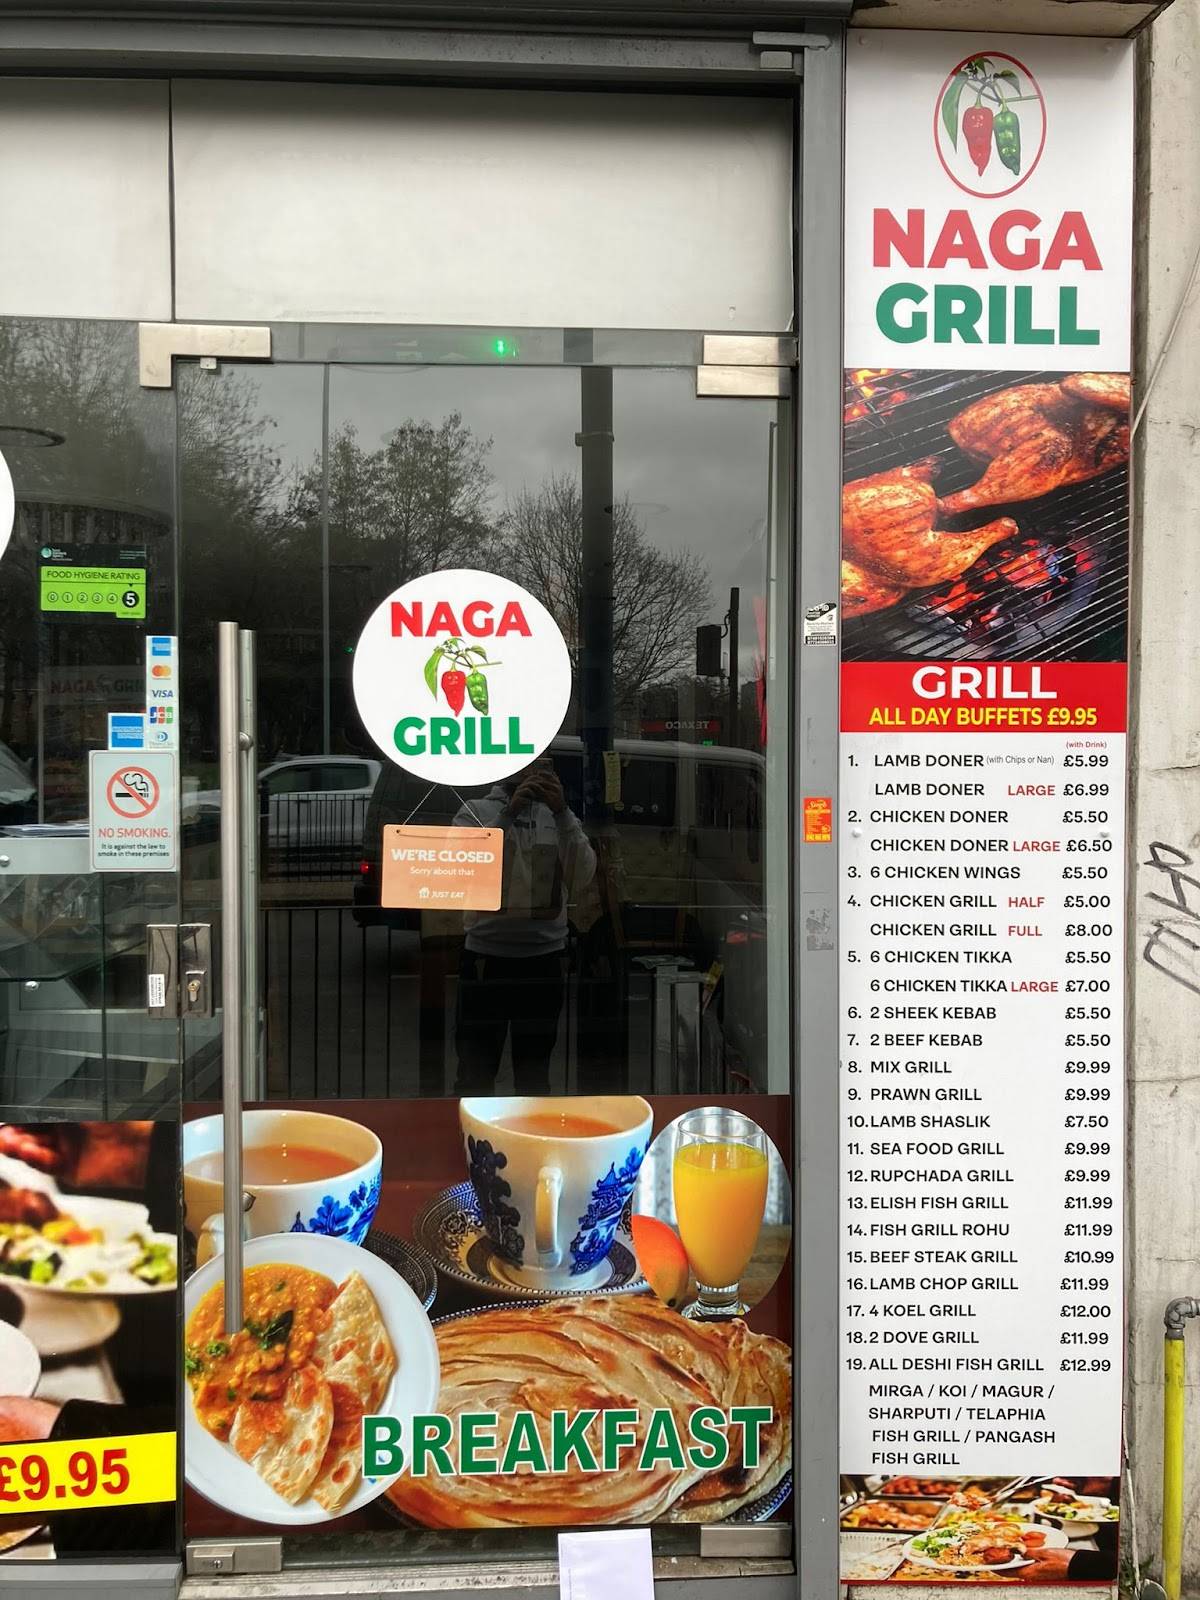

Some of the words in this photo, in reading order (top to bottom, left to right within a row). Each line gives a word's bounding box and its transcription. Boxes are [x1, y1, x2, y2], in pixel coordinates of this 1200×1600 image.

[873, 208, 1103, 271] NAGA
[875, 282, 1100, 345] GRILL
[47, 570, 72, 578] FOOD
[74, 571, 109, 579] HYGIENE
[111, 572, 140, 580] RATING
[126, 593, 136, 606] 5
[391, 600, 532, 637] NAGA
[912, 666, 1057, 699] GRILL
[152, 690, 173, 698] VISA
[869, 707, 905, 725] ALL
[911, 707, 951, 725] DAY
[957, 707, 1042, 725] BUFFETS
[1047, 707, 1097, 726] £9.95
[393, 716, 534, 756] GRILL
[1066, 741, 1084, 749] (with
[1086, 741, 1107, 749] Drink)
[875, 755, 920, 767] LAMB
[926, 755, 984, 767] DONER
[986, 755, 1003, 765] (with
[1005, 755, 1025, 766] Chips
[1028, 757, 1035, 765] or
[1037, 755, 1054, 765] Nan)
[1063, 755, 1108, 767] £5.99
[876, 784, 921, 796] LAMB
[926, 784, 984, 796] DONER
[1008, 784, 1055, 796] LARGE
[1063, 784, 1109, 796] £6.99
[848, 810, 861, 823] 2.
[870, 810, 945, 823] CHICKEN
[950, 810, 1008, 823] DONER
[1062, 810, 1108, 823] £5.50
[98, 828, 114, 838] NO
[871, 839, 945, 852] CHICKEN
[951, 839, 1008, 852] DONER
[1013, 839, 1060, 852] LARGE
[1066, 839, 1112, 852] £6.50
[391, 848, 437, 862] WE'RE
[438, 850, 495, 864] CLOSED
[410, 866, 431, 876] Sorry
[433, 867, 457, 876] about
[458, 868, 475, 876] that
[848, 866, 861, 879] 3.
[871, 866, 880, 879] 6
[885, 866, 959, 879] CHICKEN
[964, 866, 1020, 879] WINGS
[1062, 866, 1108, 879] £5.50
[431, 891, 449, 899] JUST
[450, 891, 465, 899] EAT
[847, 895, 861, 908] 4.
[870, 895, 944, 908] CHICKEN
[950, 895, 997, 908] GRILL
[1009, 895, 1045, 908] HALF
[1064, 895, 1110, 908] £5.00
[870, 924, 944, 936] CHICKEN
[950, 924, 997, 936] GRILL
[1008, 924, 1042, 936] FULL
[1065, 924, 1112, 936] £8.00
[848, 951, 860, 963] 5.
[870, 951, 880, 963] 6
[885, 951, 959, 963] CHICKEN
[963, 951, 1012, 963] TIKKA
[1065, 951, 1111, 963] £5.50
[870, 980, 880, 992] 6
[884, 980, 956, 992] CHICKEN
[960, 980, 1007, 992] TIKKA
[1011, 980, 1058, 992] LARGE
[1065, 980, 1110, 992] £7.00
[848, 1007, 861, 1019] 6.
[870, 1007, 880, 1019] 2
[884, 1007, 938, 1019] SHEEK
[943, 1007, 996, 1019] KEBAB
[1065, 1007, 1110, 1019] £5.50
[847, 1034, 859, 1046] 7.
[871, 1034, 880, 1046] 2
[885, 1034, 925, 1046] BEEF
[929, 1034, 983, 1046] KEBAB
[1065, 1034, 1110, 1046] £5.50
[848, 1061, 862, 1073] 8.
[871, 1061, 900, 1073] MIX
[905, 1061, 952, 1073] GRILL
[1065, 1061, 1110, 1073] £9.99
[848, 1088, 861, 1100] 9.
[871, 1088, 930, 1100] PRAWN
[935, 1088, 982, 1100] GRILL
[1065, 1088, 1110, 1100] £9.99
[870, 1115, 916, 1128] LAMB
[921, 1115, 990, 1128] SHASLIK
[1065, 1115, 1108, 1128] £7.50
[870, 1143, 902, 1155] SEA
[907, 1143, 953, 1155] FOOD
[958, 1143, 1004, 1155] GRILL
[1064, 1143, 1110, 1155] £9.99
[870, 1170, 963, 1182] RUPCHADA
[967, 1170, 1014, 1182] GRILL
[1064, 1170, 1110, 1182] £9.99
[871, 1197, 916, 1209] ELISH
[922, 1197, 957, 1209] FISH
[962, 1197, 1009, 1209] GRILL
[1064, 1197, 1112, 1209] £11.99
[871, 1224, 906, 1236] FISH
[911, 1224, 958, 1236] GRILL
[963, 1224, 1009, 1236] ROHU
[1064, 1224, 1112, 1236] £11.99
[871, 1251, 910, 1263] BEEF
[914, 1251, 967, 1263] STEAK
[971, 1251, 1018, 1263] GRILL
[1064, 1251, 1114, 1263] £10.99
[870, 1278, 915, 1290] LAMB
[920, 1278, 967, 1290] CHOP
[972, 1278, 1018, 1290] GRILL
[1060, 1278, 1109, 1290] £11.99
[870, 1305, 879, 1317] 4
[884, 1305, 925, 1317] KOEL
[930, 1305, 976, 1317] GRILL
[1060, 1305, 1111, 1317] £12.00
[869, 1332, 879, 1344] 2
[884, 1332, 928, 1344] DOVE
[932, 1332, 979, 1344] GRILL
[1060, 1332, 1108, 1344] £11.99
[869, 1358, 898, 1371] ALL
[903, 1358, 951, 1371] DESHI
[956, 1358, 992, 1371] FISH
[997, 1358, 1044, 1371] GRILL
[1060, 1358, 1111, 1371] £12.99
[870, 1385, 923, 1398] MIRGA
[939, 1385, 966, 1398] KOI
[983, 1385, 1044, 1398] MAGUR
[869, 1408, 950, 1420] SHARPUTI
[966, 1408, 1046, 1420] TELAPHIA
[361, 1406, 774, 1478] BREAKFAST
[873, 1430, 908, 1443] FISH
[914, 1430, 960, 1443] GRILL
[976, 1430, 1055, 1443] PANGASH
[872, 1452, 908, 1464] FISH
[913, 1452, 960, 1464] GRILL
[0, 1448, 130, 1502] £9.95
